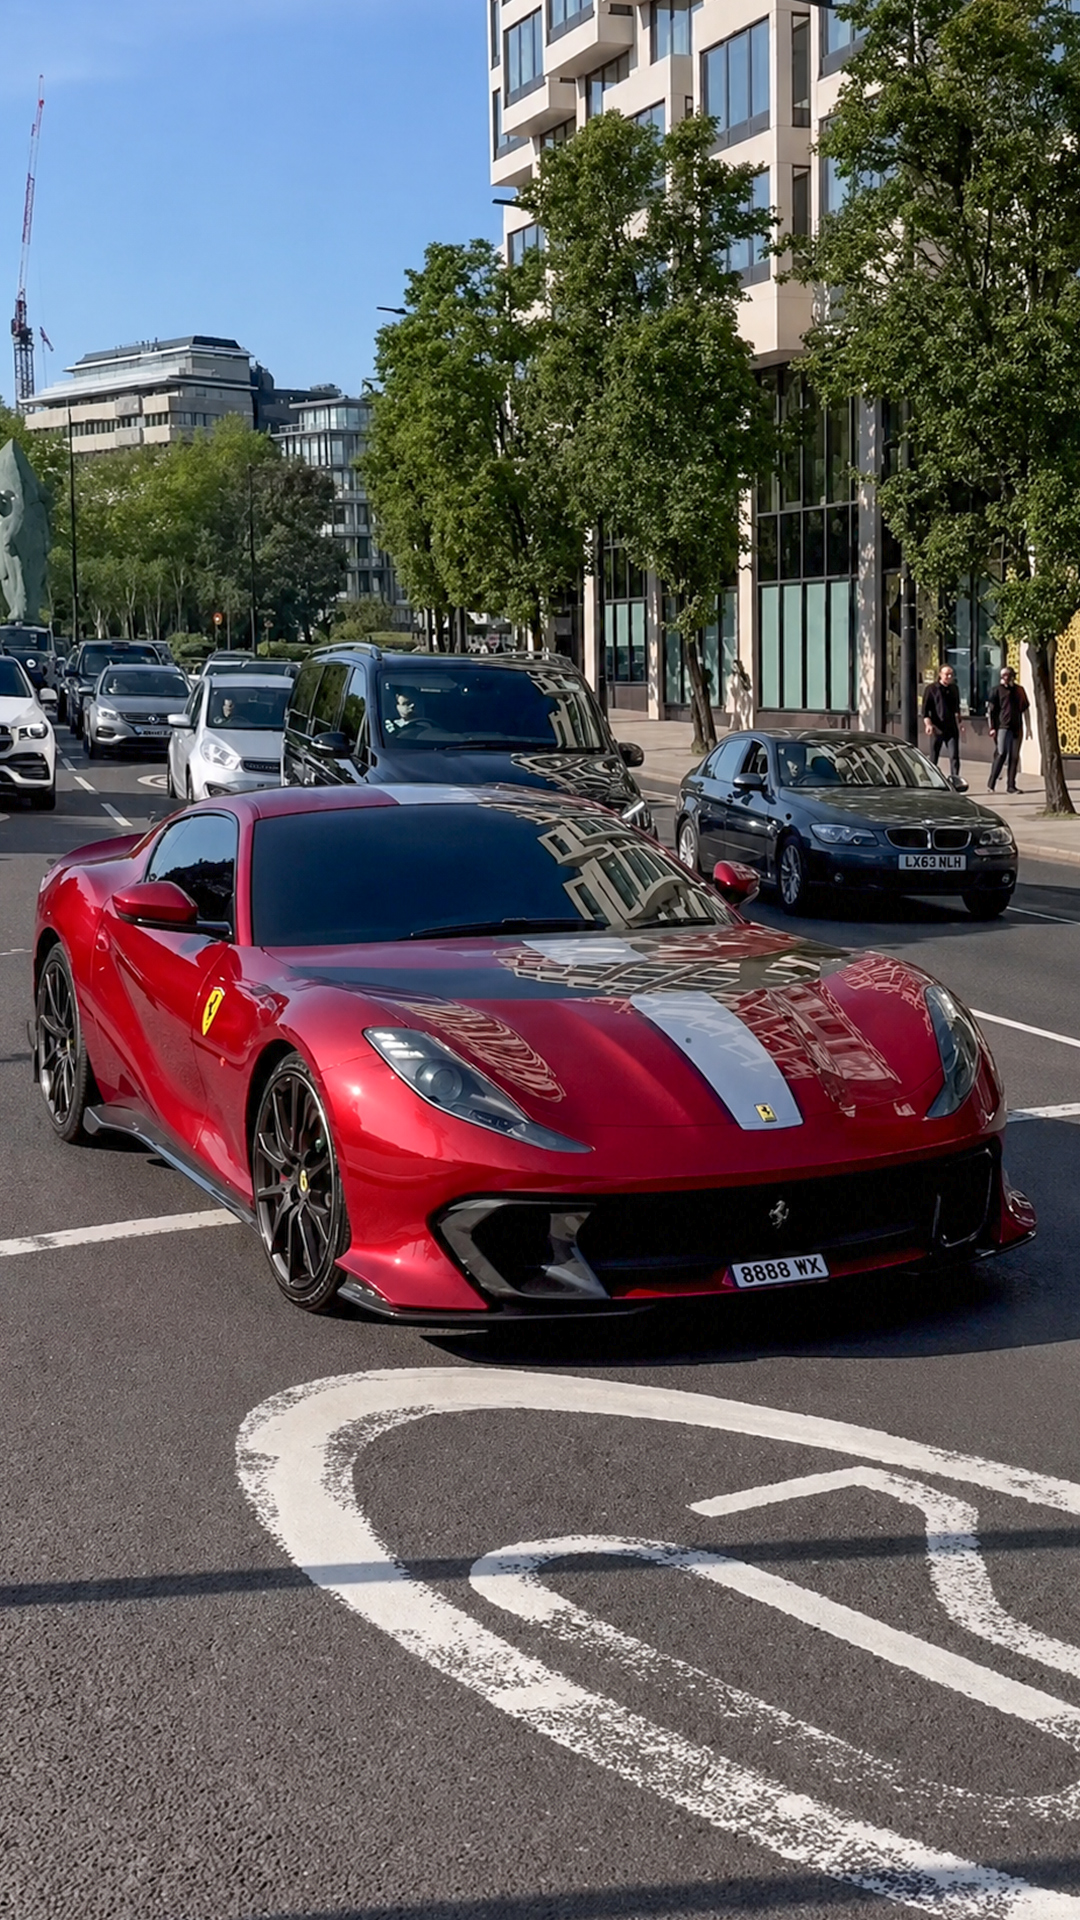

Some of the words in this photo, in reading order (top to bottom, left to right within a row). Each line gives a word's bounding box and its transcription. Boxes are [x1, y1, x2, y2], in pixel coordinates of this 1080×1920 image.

[905, 856, 937, 868] LX63
[939, 856, 961, 868] NLH
[740, 1261, 791, 1283] 8888
[794, 1257, 823, 1276] WX
